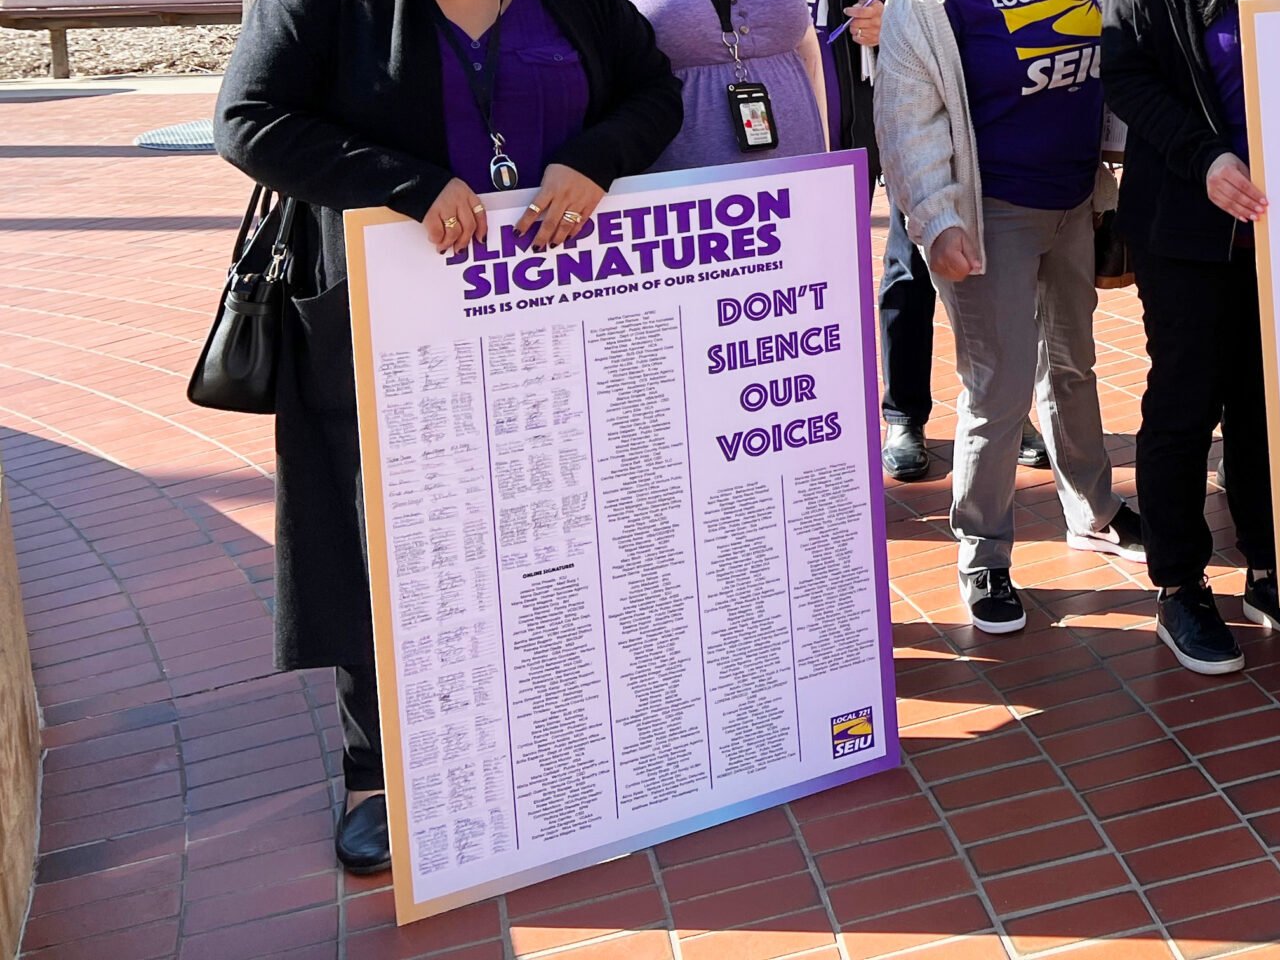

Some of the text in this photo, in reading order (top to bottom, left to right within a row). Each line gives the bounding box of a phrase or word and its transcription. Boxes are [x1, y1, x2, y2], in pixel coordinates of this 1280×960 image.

[462, 222, 782, 301] SIGNATURES
[464, 260, 784, 318] THIS IS ONLY A PORTION OF OUR SIGNATURES!
[716, 281, 828, 328] DON'T
[706, 323, 841, 375] SILENCE
[739, 373, 817, 413] OUR
[715, 411, 842, 463] VOICES
[543, 563, 575, 575] SIGNATURES
[832, 708, 871, 725] LOCAL 721
[834, 734, 873, 758] SEIU
